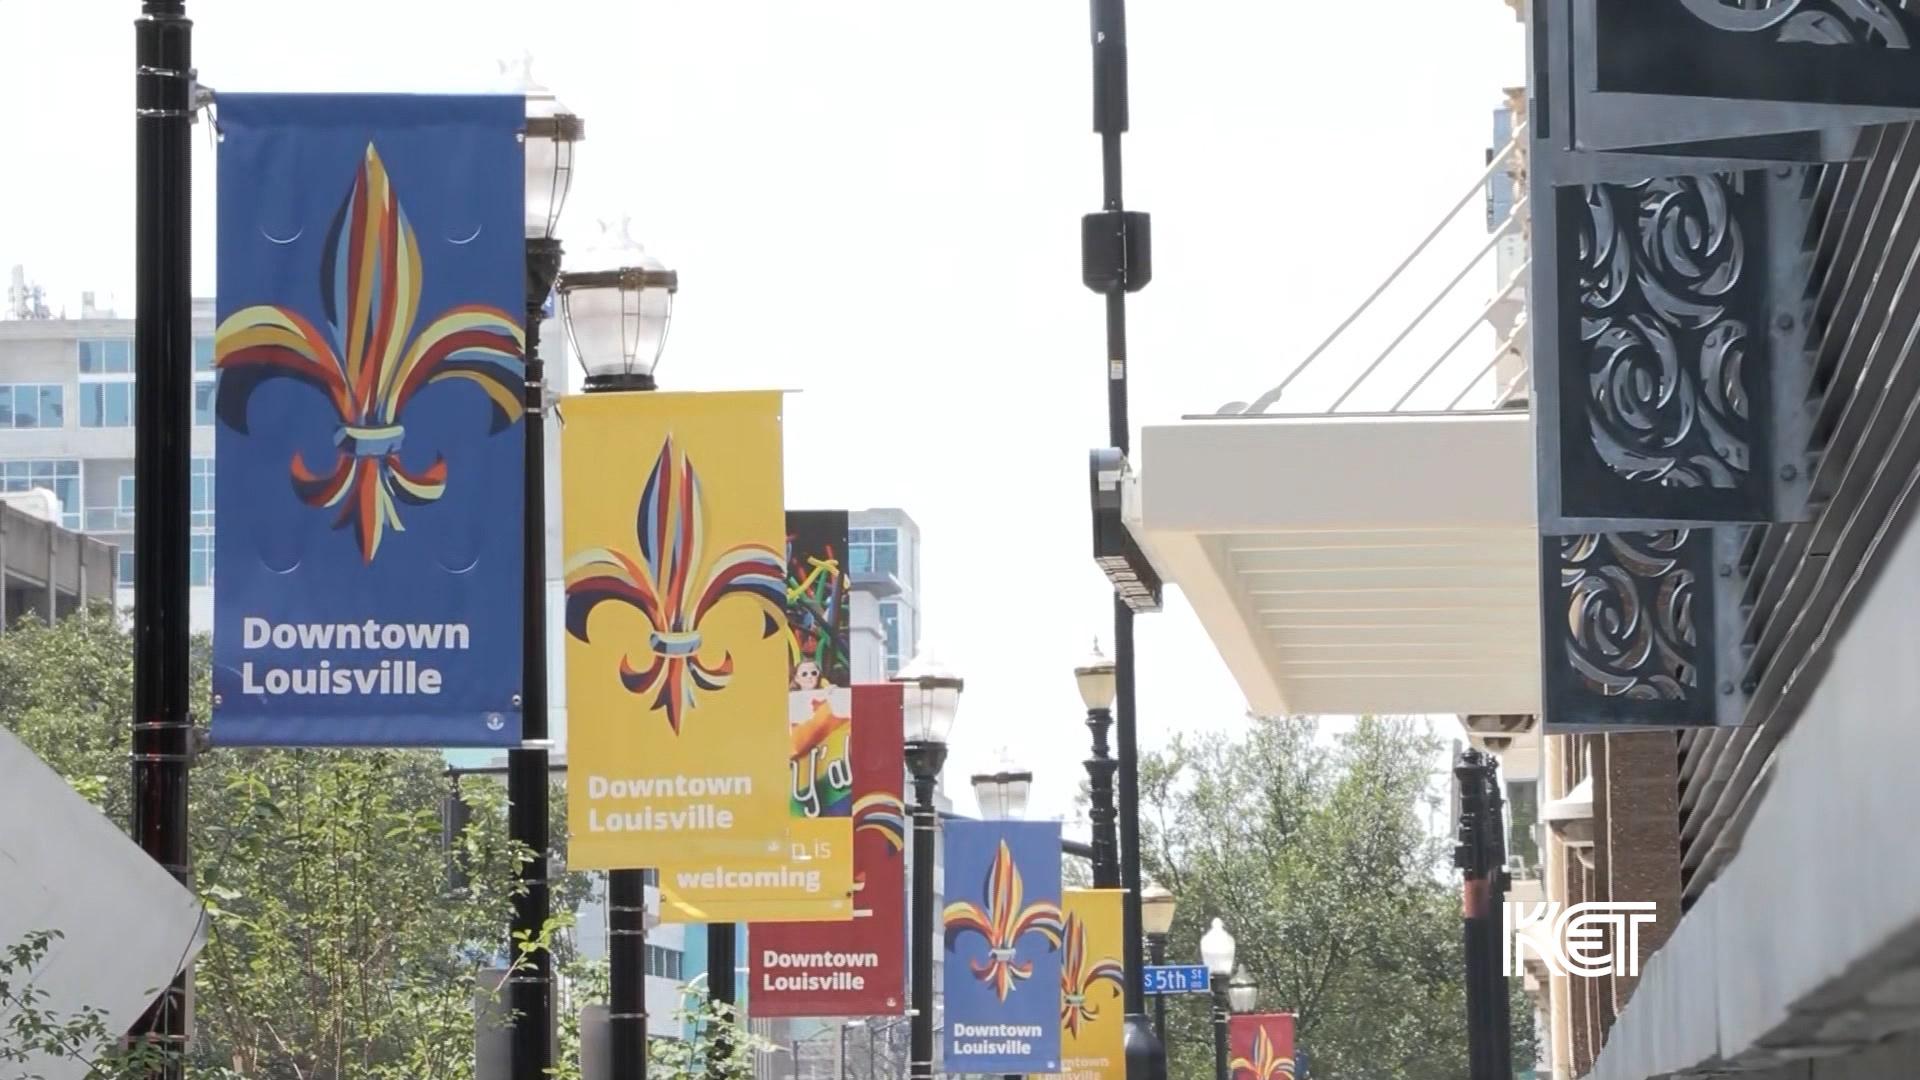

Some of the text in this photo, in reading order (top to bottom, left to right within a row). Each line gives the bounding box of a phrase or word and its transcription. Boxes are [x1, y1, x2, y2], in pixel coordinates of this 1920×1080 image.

[244, 617, 470, 649] Downtown
[243, 660, 442, 695] Louisville
[588, 774, 752, 799] Downtown
[588, 804, 734, 832] Louisville
[677, 866, 821, 892] welcoming
[763, 950, 878, 968] Downtown
[763, 972, 865, 991] Louisville
[1156, 970, 1187, 989] 5th
[954, 1023, 1042, 1037] Downtown
[954, 1040, 1031, 1055] Louisville
